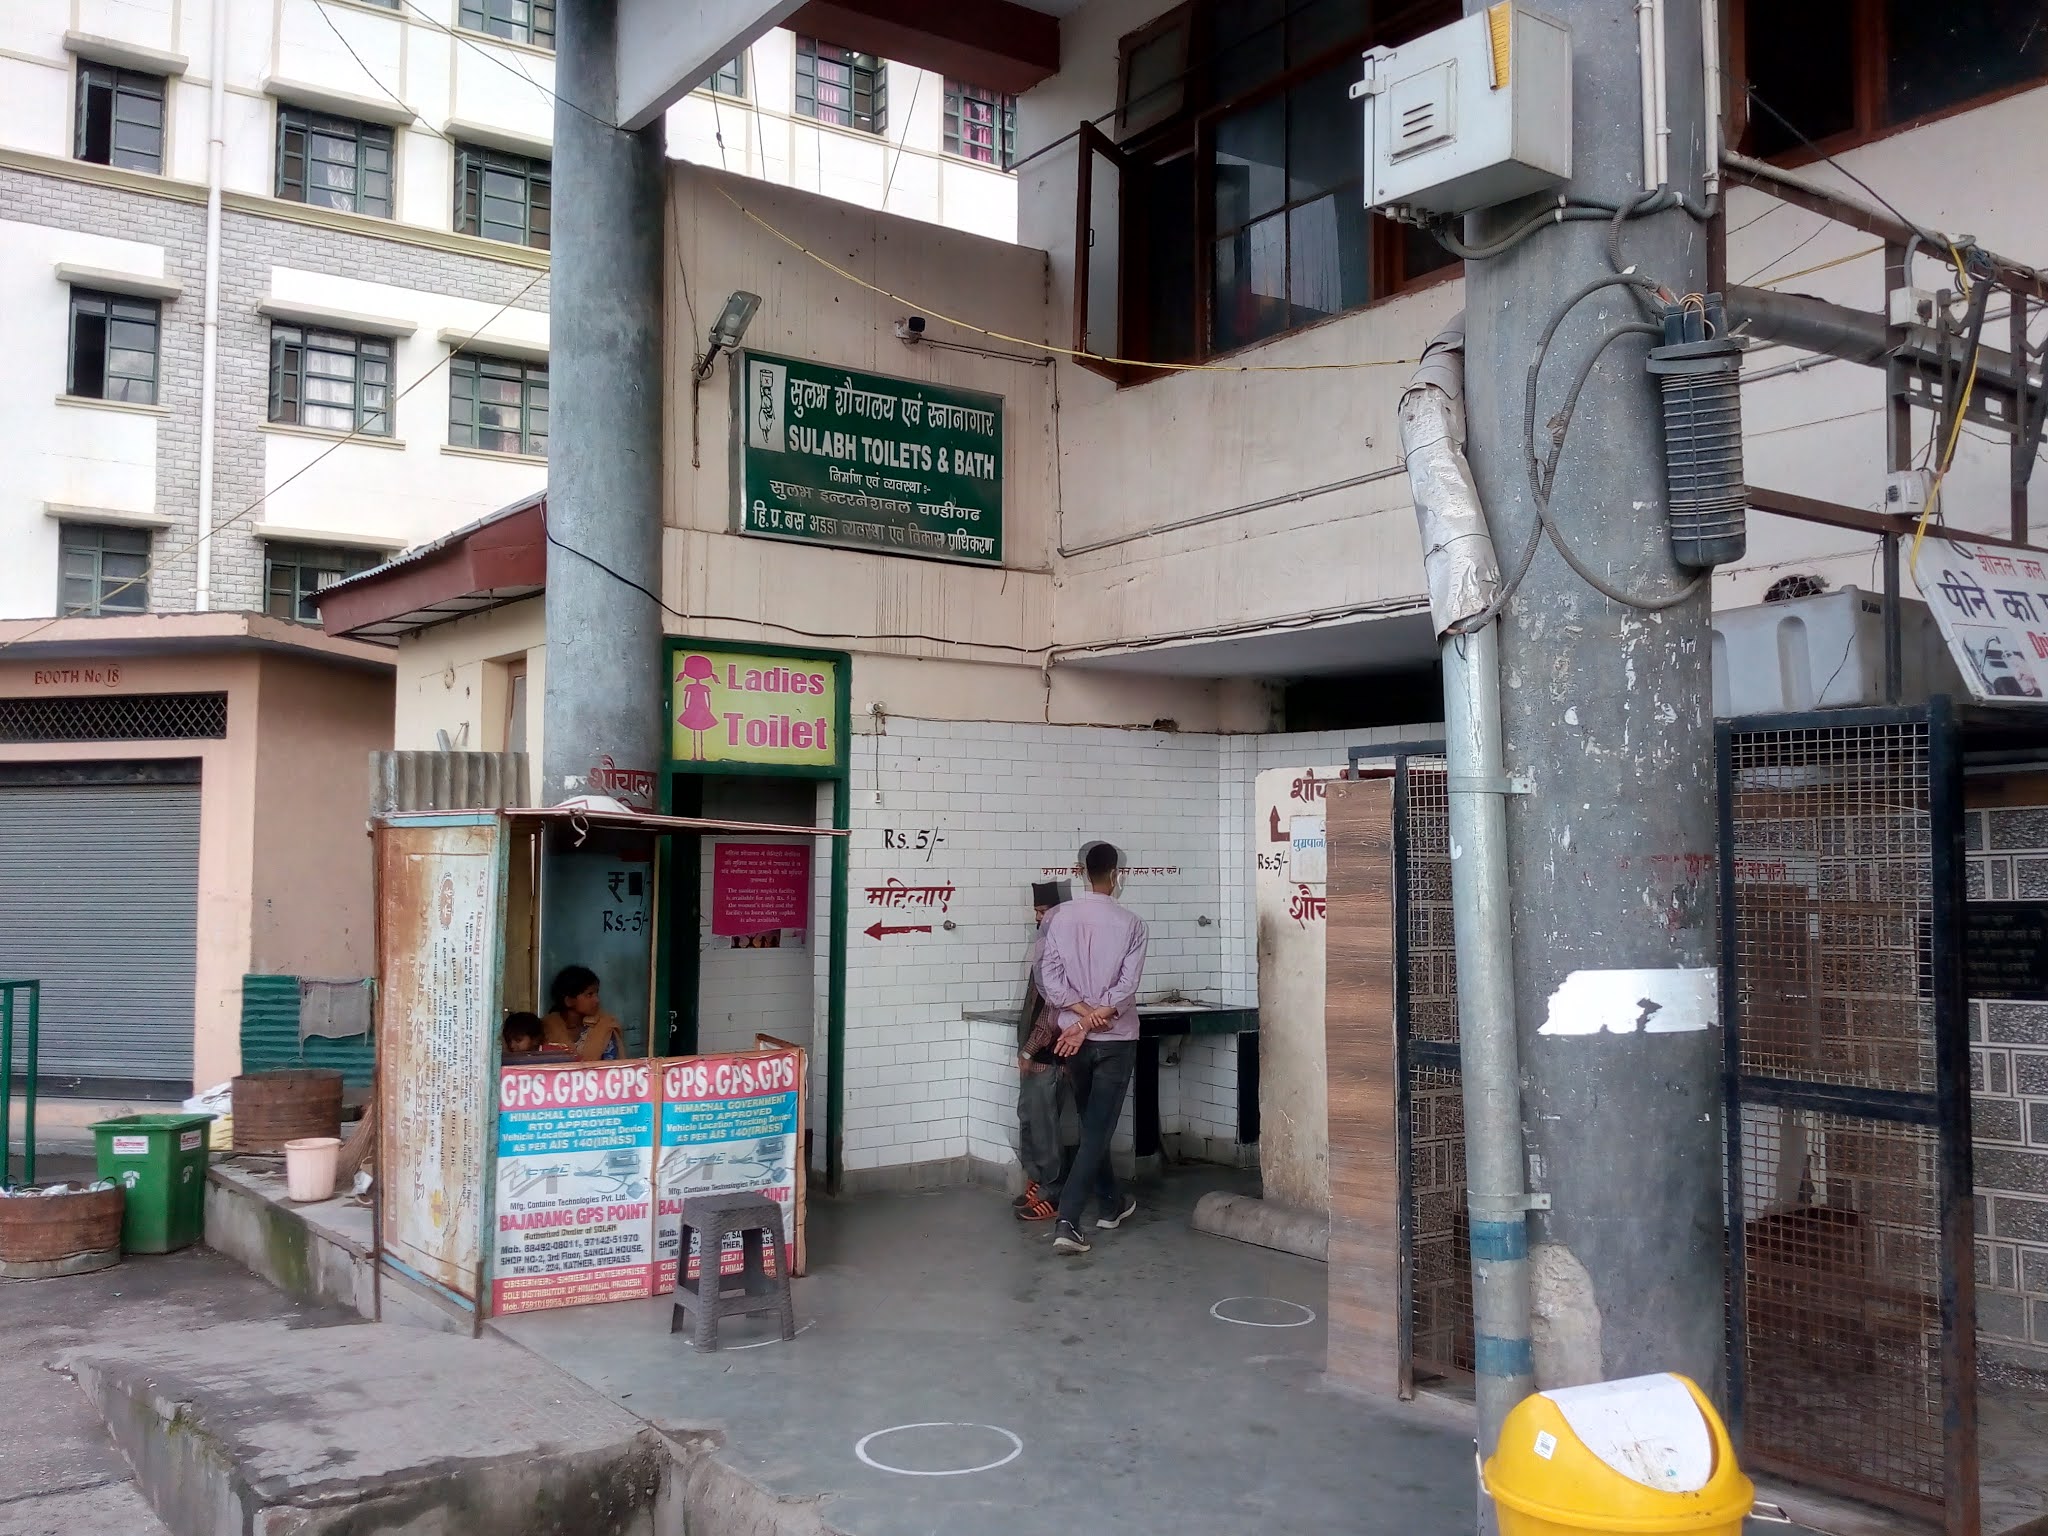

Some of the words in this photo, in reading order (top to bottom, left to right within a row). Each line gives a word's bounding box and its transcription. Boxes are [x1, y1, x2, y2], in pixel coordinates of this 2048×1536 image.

[790, 378, 831, 418] सुलभ
[835, 377, 897, 421] शौचालय
[902, 392, 923, 428] एवं
[928, 402, 994, 436] स्नानागार
[789, 424, 857, 461] SULABH
[862, 436, 932, 471] TOILETS
[937, 447, 949, 473] &
[955, 449, 995, 480] BATH
[829, 465, 862, 486] निर्माण
[866, 472, 880, 489] एवं
[769, 480, 814, 500] सुलभ
[908, 522, 945, 548] विकास
[947, 528, 995, 554] प्राधिकरण
[1937, 569, 1996, 620] पीने
[1992, 588, 2041, 623] का
[35, 670, 79, 685] BOOTH
[84, 669, 101, 684] No
[106, 668, 120, 683] 18
[727, 664, 826, 696] Ladies
[722, 712, 828, 750] Toilet
[884, 829, 910, 850] Rs.
[916, 826, 945, 862] 5/-
[674, 1102, 725, 1113] HIMACHAL
[727, 1094, 787, 1110] GOVERNMENT
[510, 1108, 565, 1122] HIMACHAL
[567, 1104, 641, 1119] GOVERNMENT
[691, 1113, 714, 1122] RTO
[717, 1107, 772, 1120] APPROVED
[528, 1121, 553, 1131] RTO
[555, 1117, 622, 1130] APPROVED
[666, 1123, 697, 1132] Vehicle
[699, 1120, 733, 1130] Location
[735, 1117, 767, 1128] Tracking
[502, 1132, 535, 1142] Vehicle
[536, 1130, 576, 1140] Location
[577, 1126, 616, 1138] Tracking
[617, 1125, 648, 1134] Device
[690, 1133, 708, 1141] PER
[709, 1129, 727, 1140] AIS
[512, 1143, 527, 1152] AS
[528, 1142, 547, 1151] PER
[549, 1139, 569, 1149] AIS
[668, 1187, 681, 1195] Mfg.
[711, 1181, 749, 1191] Technologies
[510, 1202, 526, 1211] Mfg.
[557, 1197, 600, 1207] Technologies
[601, 1194, 614, 1203] Pvt.
[615, 1193, 628, 1202] Ltd.
[500, 1210, 573, 1232] BAJARANG
[576, 1206, 604, 1224] GPS
[607, 1203, 649, 1221] POINT
[658, 1229, 679, 1238] Mob.
[501, 1245, 521, 1255] Mob.
[658, 1238, 679, 1249] SHOP
[722, 1240, 743, 1250] THER,
[501, 1256, 522, 1266] SHOP
[547, 1253, 560, 1262] 3rd
[561, 1251, 582, 1261] Floor,
[615, 1244, 644, 1254] HOUSE,
[513, 1265, 526, 1275] NH
[597, 1255, 632, 1266] BYEPASS
[660, 1272, 676, 1282] SOLE
[502, 1291, 520, 1300] SOLE
[521, 1286, 567, 1299] DISTRIBUTOR
[567, 1285, 578, 1294] OF
[659, 1283, 675, 1293] Mob.
[502, 1302, 519, 1311] Mob.
